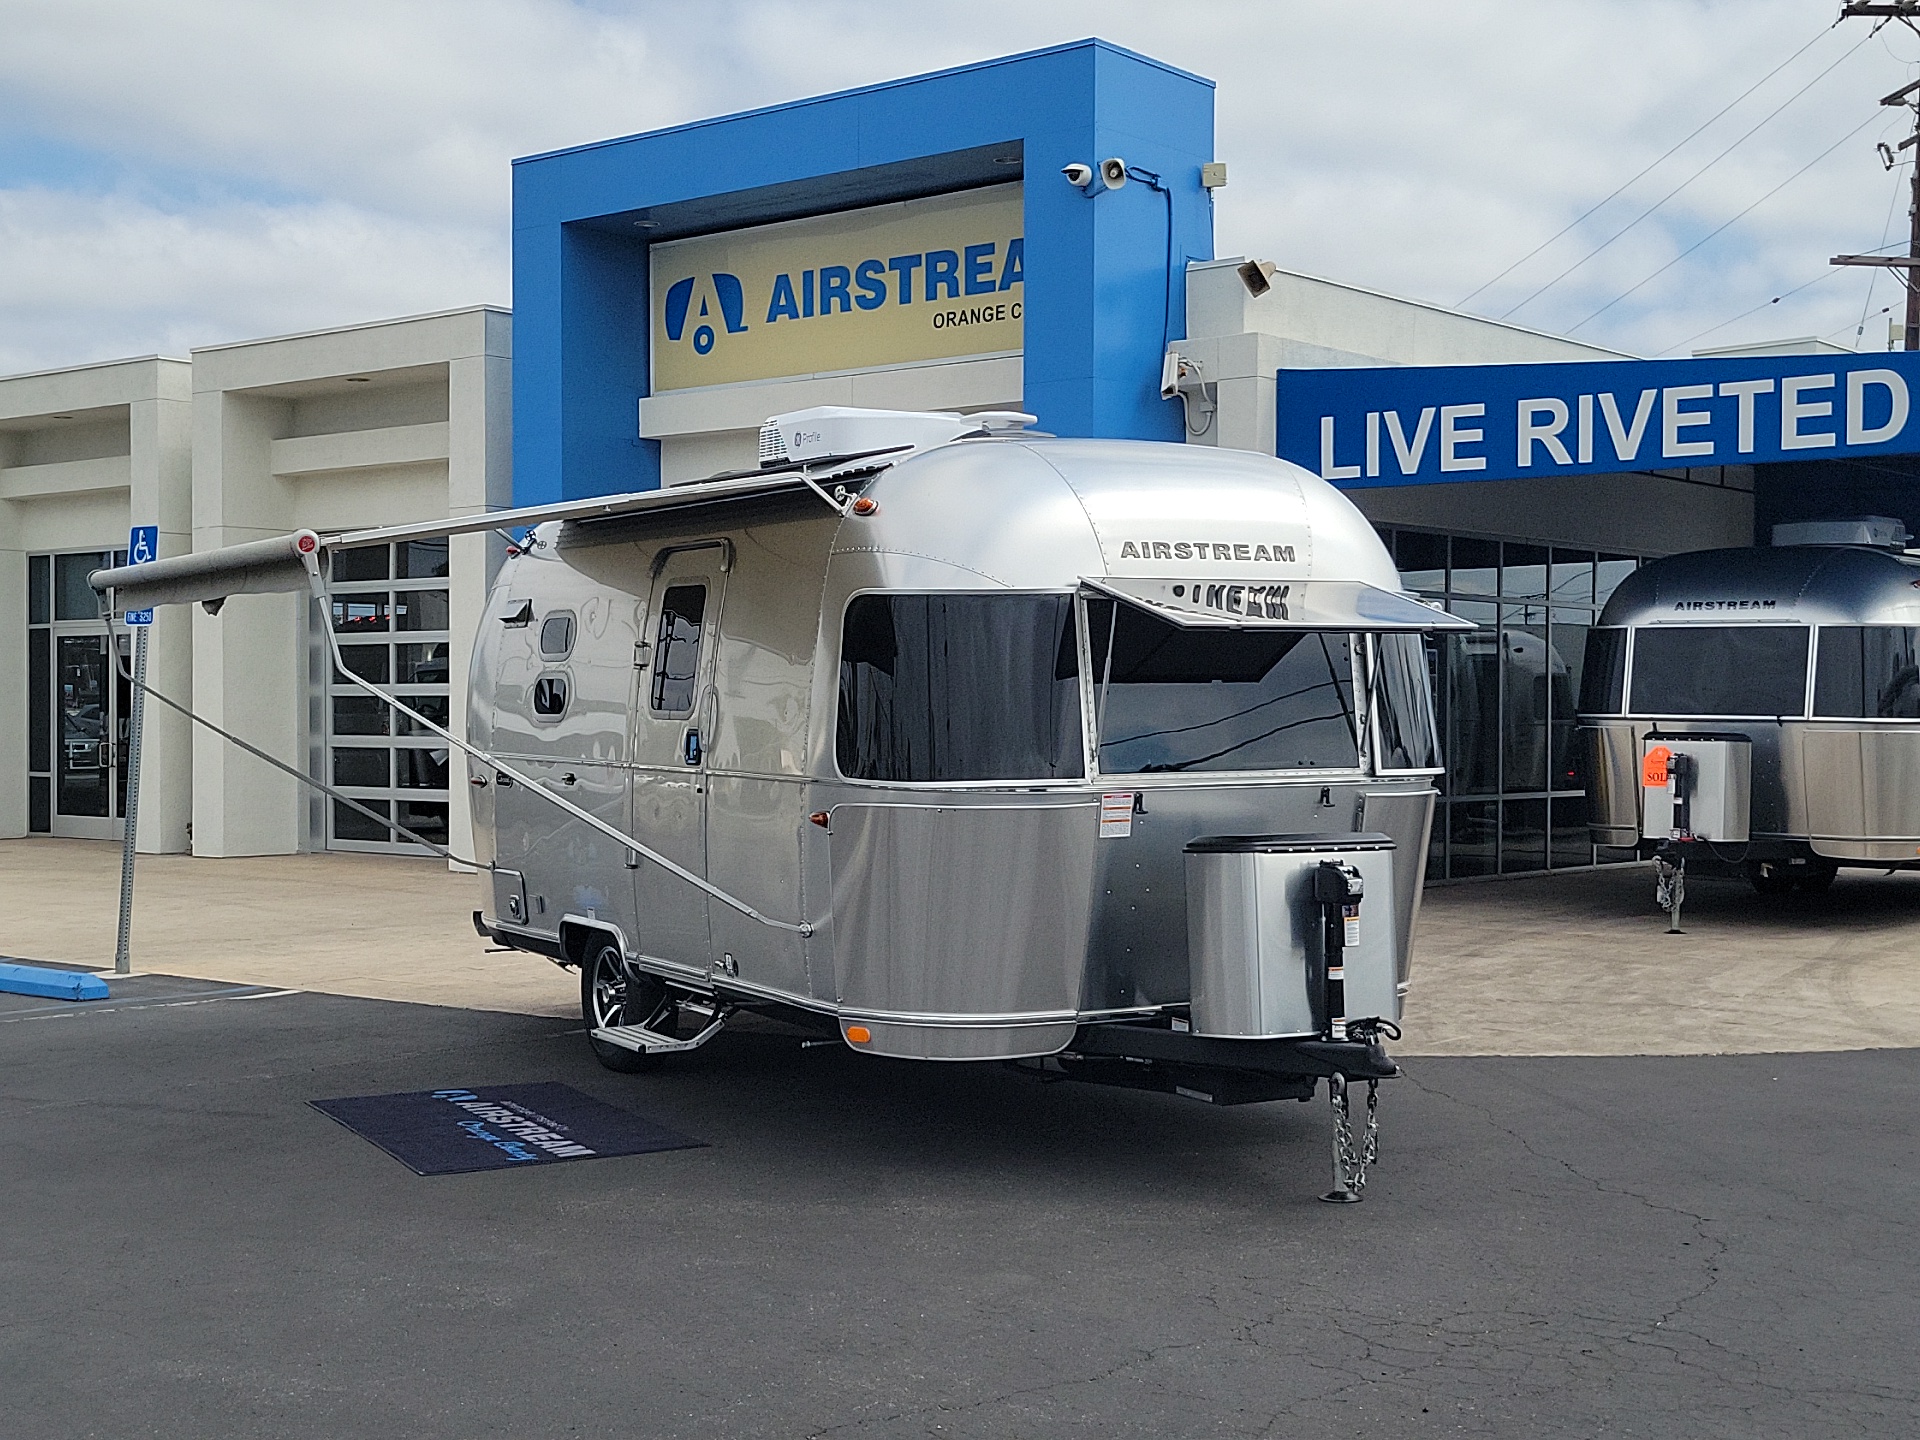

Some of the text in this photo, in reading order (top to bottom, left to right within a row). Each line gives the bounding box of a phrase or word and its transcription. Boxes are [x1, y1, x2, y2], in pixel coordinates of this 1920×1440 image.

[766, 237, 1024, 324] AIRSTREA
[932, 305, 1006, 329] ORANGE
[1320, 368, 1910, 480] LIVE RIVETED
[1120, 541, 1296, 563] AIRSTREAM
[1674, 600, 1777, 611] AIRSTREAM
[1647, 772, 1667, 782] SOL
[454, 1101, 597, 1158] AIRSTREAM
